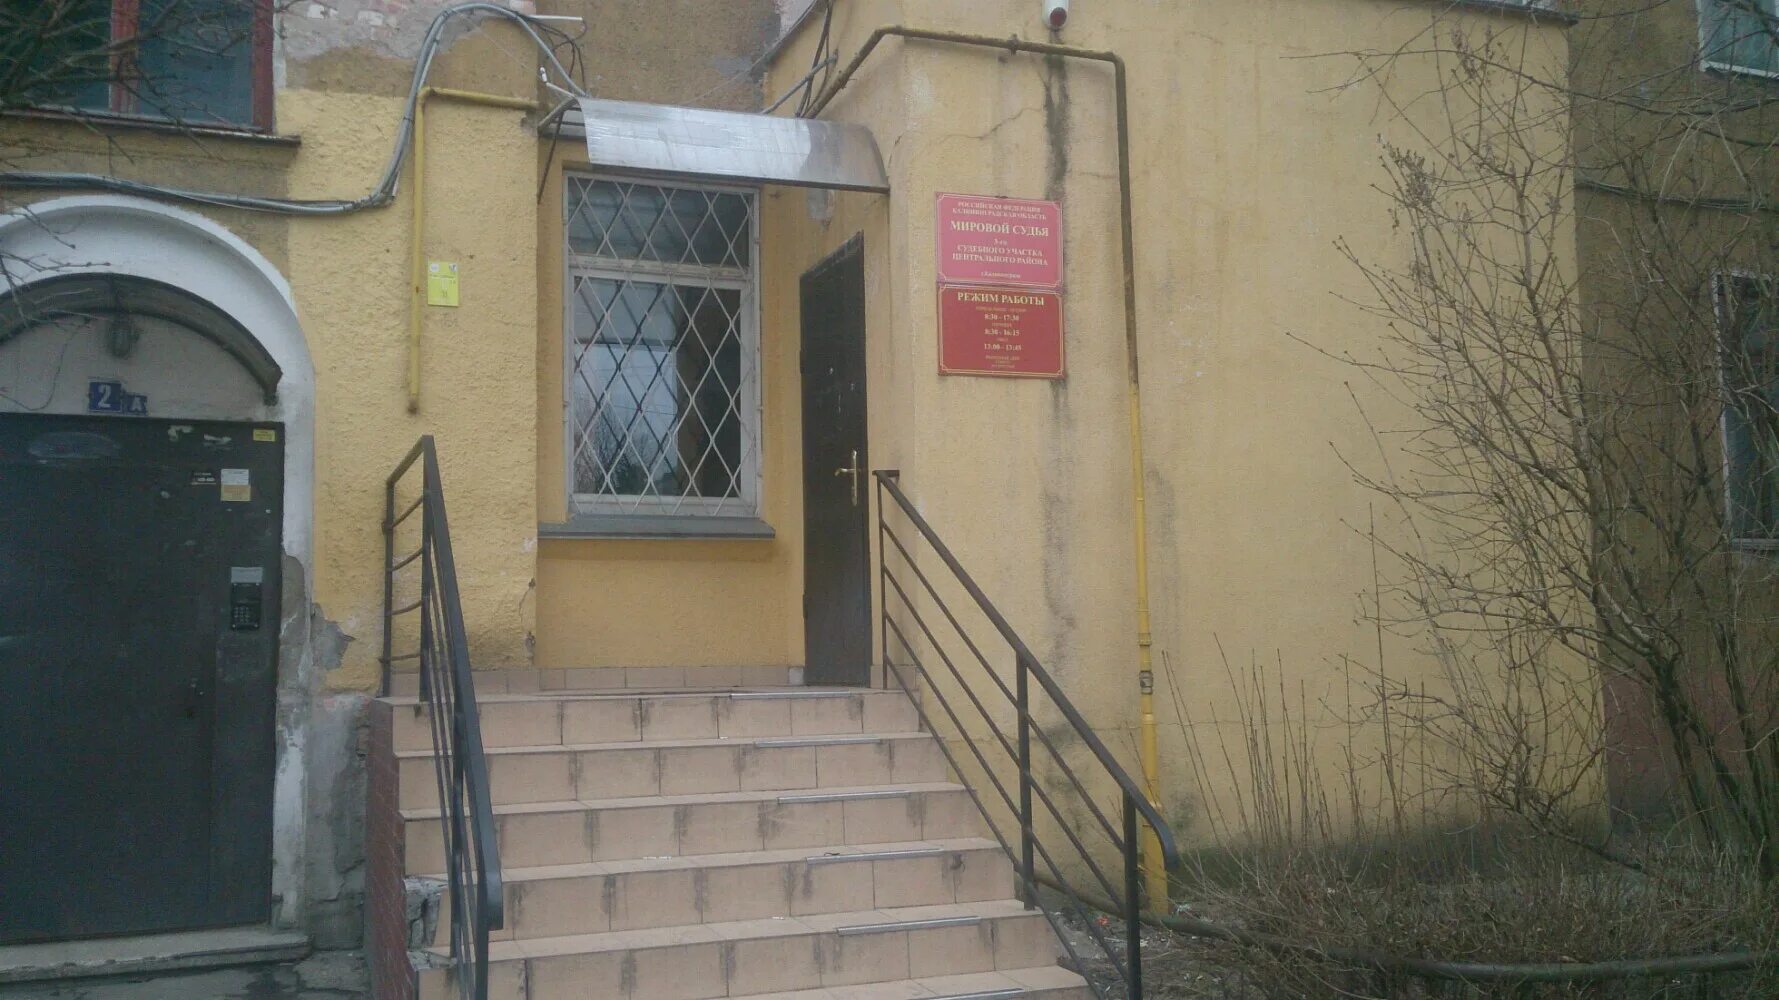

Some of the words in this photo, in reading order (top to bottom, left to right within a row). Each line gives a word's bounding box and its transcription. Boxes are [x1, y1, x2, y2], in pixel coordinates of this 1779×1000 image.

[951, 220, 1009, 234] МИРОВОЙ
[1012, 224, 1049, 237] СУДЬЯ
[957, 244, 1005, 255] СУДЕБНОГО
[1006, 248, 1043, 257] УЧАСТКА
[952, 252, 1015, 264] ЦЕНТРАЛЬНОГО
[1017, 256, 1048, 266] РАЙОНА
[957, 291, 999, 303] РЕЖИМ
[1001, 294, 1044, 306] РАБОТЫ
[98, 384, 111, 409] 2
